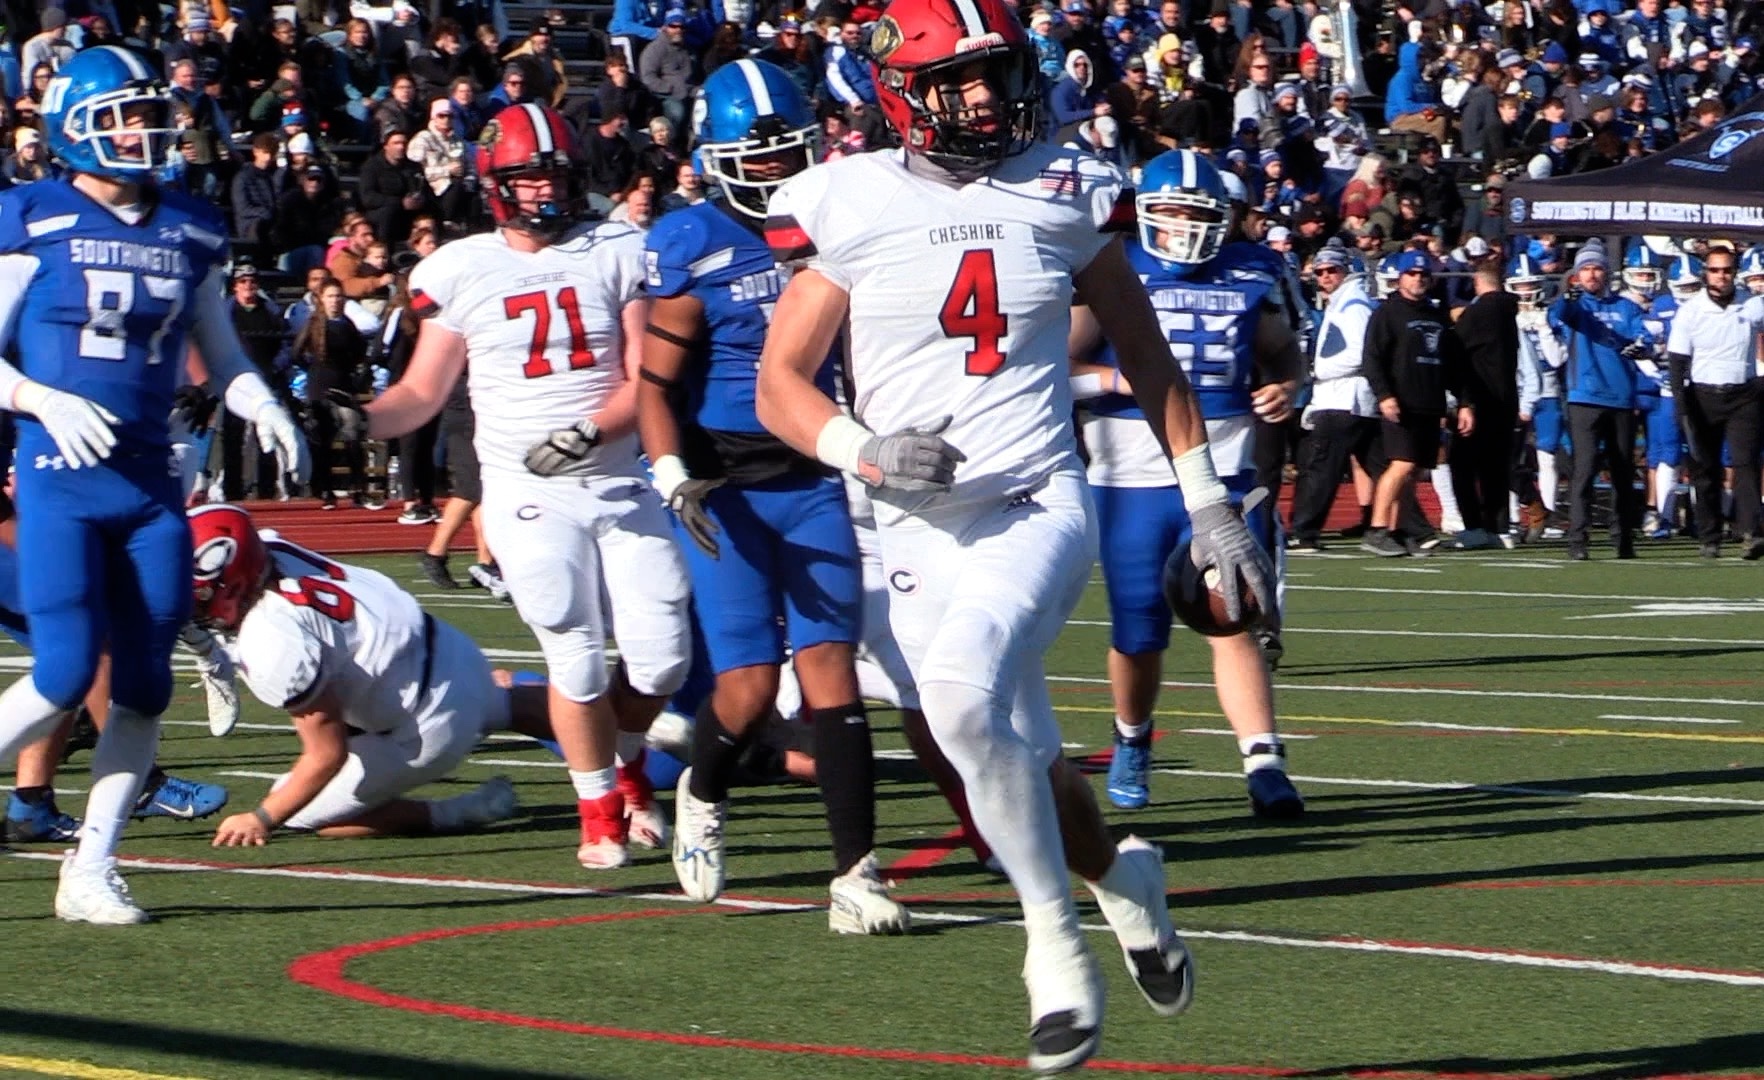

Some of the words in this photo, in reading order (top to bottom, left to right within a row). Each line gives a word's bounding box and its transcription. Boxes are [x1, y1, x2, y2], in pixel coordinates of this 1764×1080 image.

[1613, 201, 1647, 221] BLUE
[1648, 202, 1701, 223] KNIGHTS
[929, 223, 1005, 245] CHESHIRE
[79, 268, 187, 365] 87
[938, 247, 1008, 377] 4
[503, 286, 599, 379] 71
[517, 504, 542, 521] C
[890, 570, 917, 593] C
